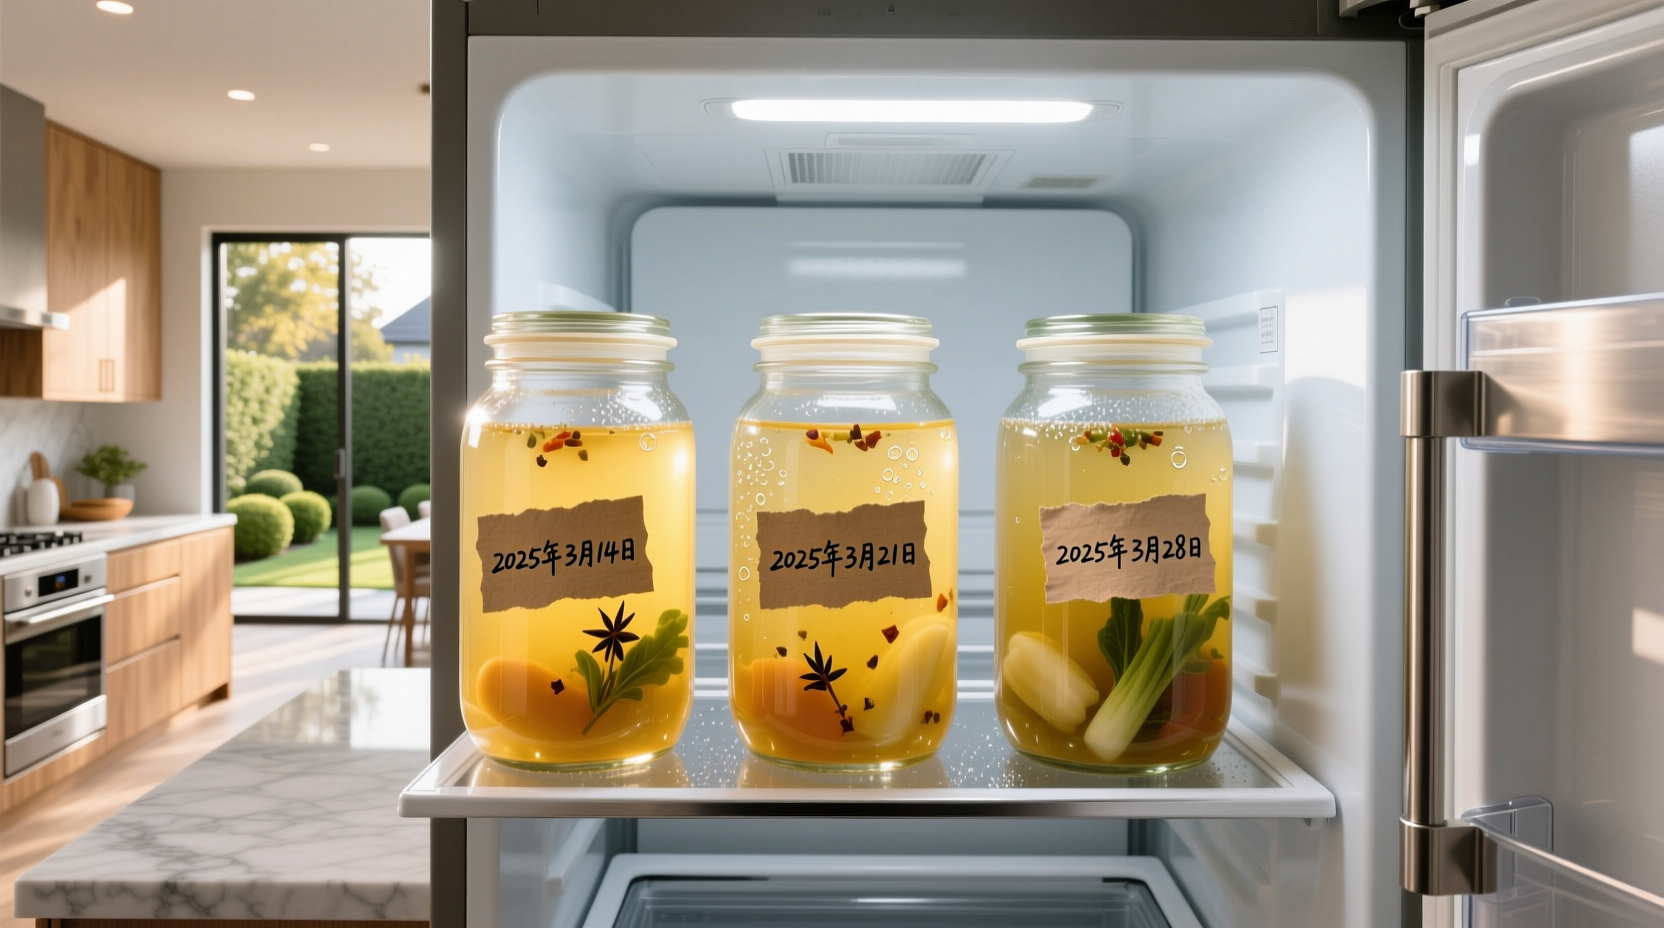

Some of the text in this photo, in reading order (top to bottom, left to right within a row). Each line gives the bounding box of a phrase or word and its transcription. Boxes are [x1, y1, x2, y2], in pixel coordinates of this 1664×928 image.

[491, 538, 635, 576] 2025年3月14日
[769, 539, 916, 577] 2025年3月21日
[1055, 533, 1201, 570] 2025年3月28日
